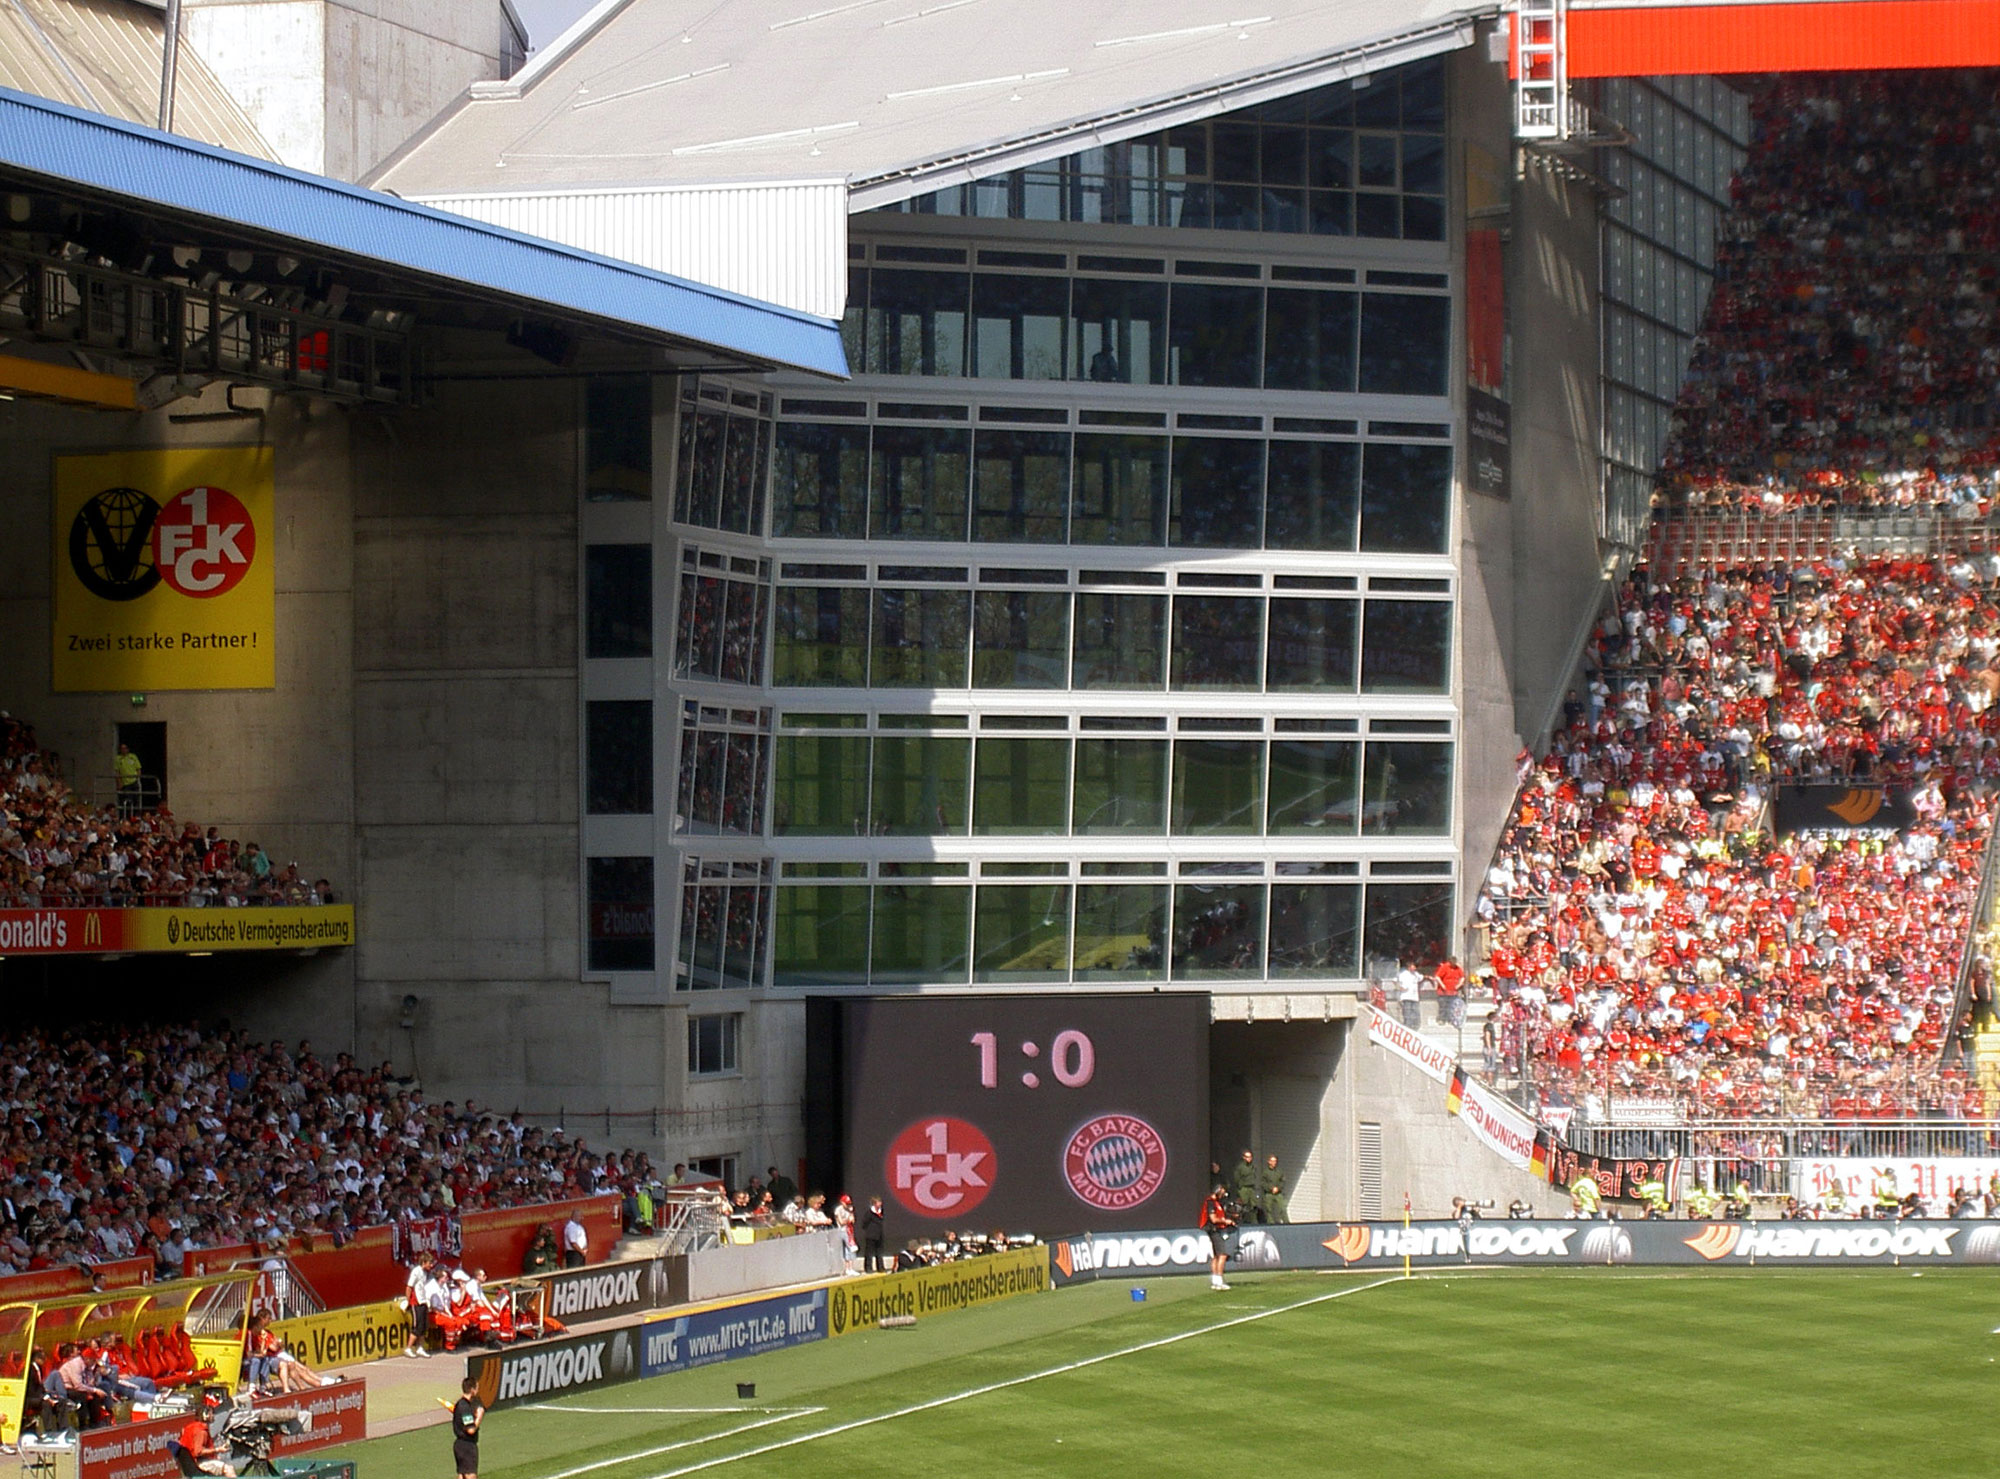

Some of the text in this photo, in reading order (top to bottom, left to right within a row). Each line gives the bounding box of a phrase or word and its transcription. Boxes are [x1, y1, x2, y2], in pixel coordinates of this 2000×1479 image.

[68, 634, 111, 651] Zwei
[117, 633, 174, 650] starke
[0, 911, 67, 948] onald's
[183, 918, 349, 945] Deutsche Vermögensberatung
[1071, 1119, 1160, 1158] FC BAYERN
[1071, 1169, 1161, 1208] MÜNCHEN
[851, 1264, 1044, 1327] Deutsche Vermögensberatung
[312, 1317, 412, 1365] Vermögen
[308, 1397, 335, 1416] einfach
[336, 1390, 365, 1415] günstig!
[83, 1442, 122, 1464] Champion
[123, 1439, 132, 1456] in
[132, 1437, 147, 1454] der
